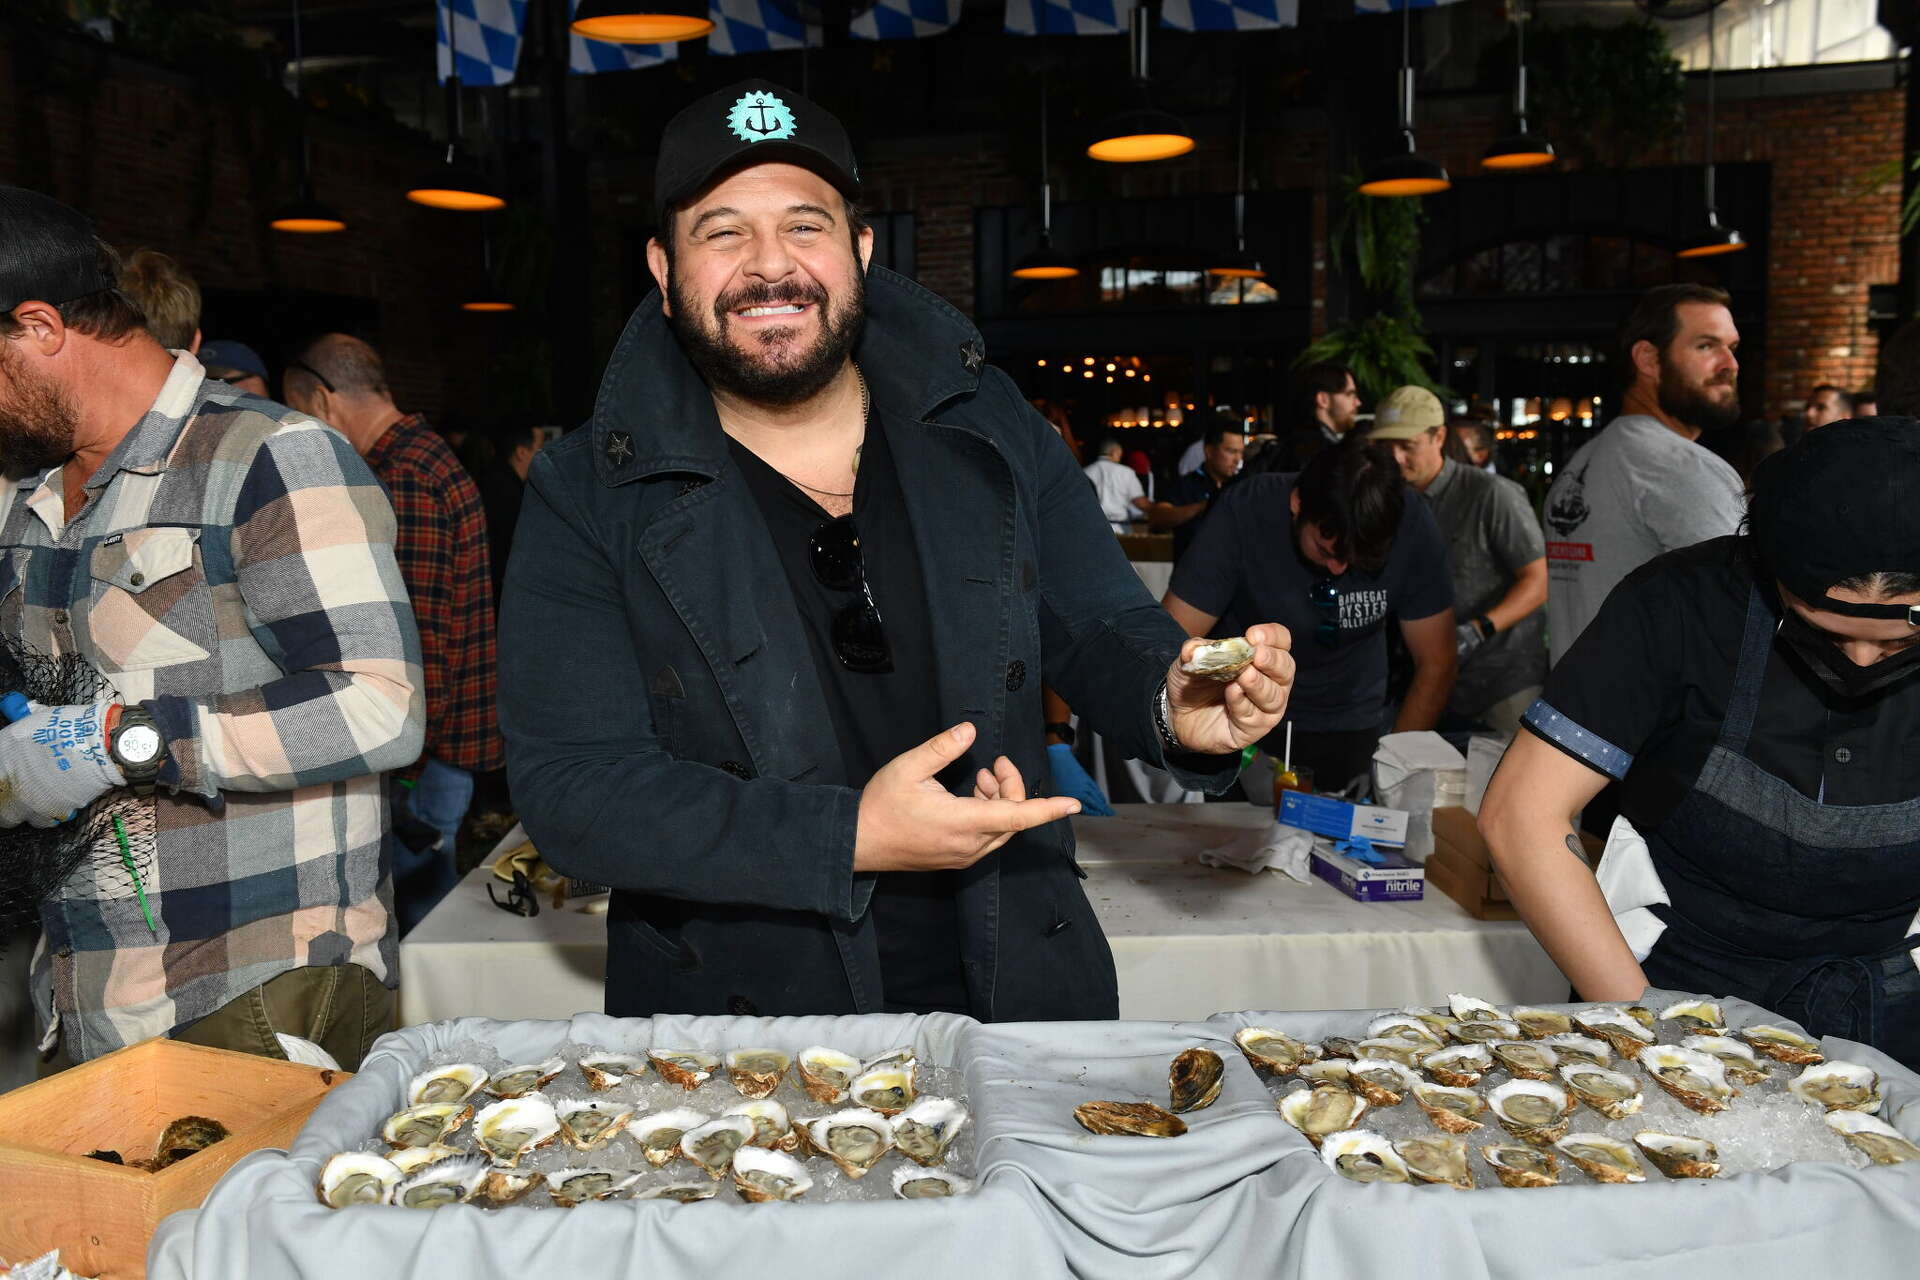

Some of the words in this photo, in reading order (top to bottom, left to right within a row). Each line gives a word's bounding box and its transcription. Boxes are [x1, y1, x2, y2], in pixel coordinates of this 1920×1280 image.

[1338, 590, 1387, 606] BARNEGAT
[1339, 600, 1387, 621] OYSTER
[59, 719, 75, 750] 300
[1386, 880, 1421, 892] nitrile
